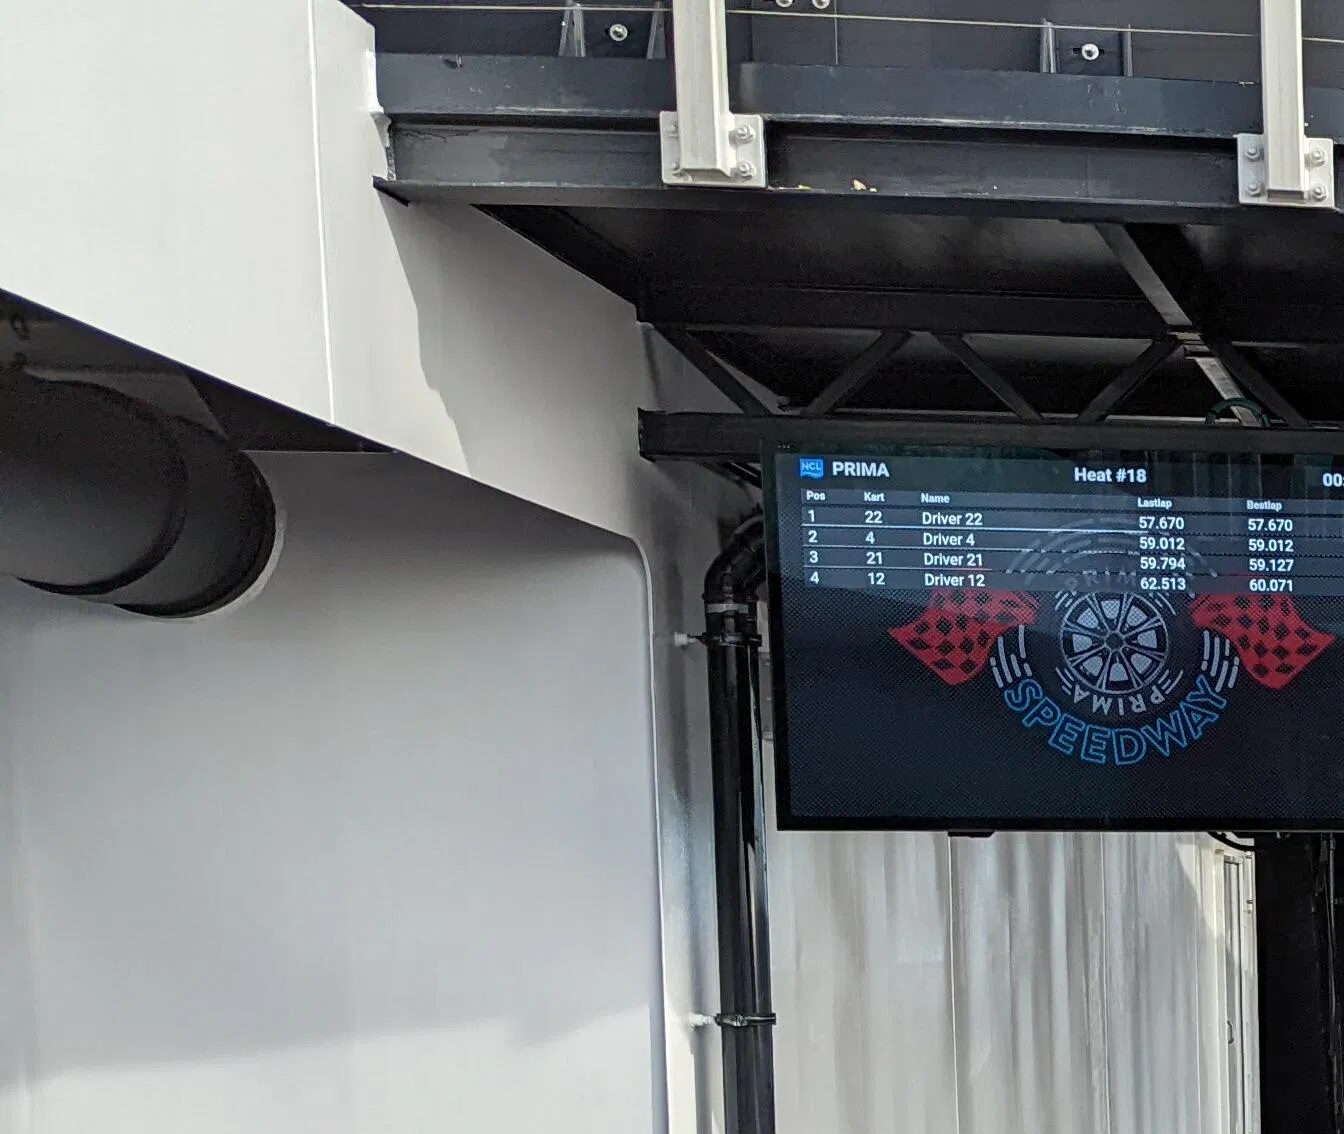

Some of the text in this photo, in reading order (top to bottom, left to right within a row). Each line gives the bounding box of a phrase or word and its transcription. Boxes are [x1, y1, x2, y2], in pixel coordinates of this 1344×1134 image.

[801, 461, 821, 471] NCL
[832, 461, 890, 478] PRIMA
[1074, 467, 1147, 483] Heat #18
[806, 490, 826, 501] Pos
[864, 491, 885, 502] Kart
[920, 493, 950, 504] Name
[1137, 498, 1172, 510] Lastlap
[1246, 500, 1282, 512] Bestlap
[808, 510, 815, 523] 1
[864, 510, 883, 524] 22
[922, 512, 962, 525] Driver
[965, 513, 983, 526] 22
[1138, 516, 1185, 530] 57.670
[1247, 518, 1293, 532] 57.670
[808, 530, 818, 543] 2
[865, 531, 876, 545] 4
[923, 533, 963, 546] Driver
[965, 533, 976, 546] 4
[1139, 536, 1186, 551] 59.012
[1248, 538, 1294, 553] 59.012
[809, 550, 819, 564] 3
[866, 551, 883, 565] 21
[923, 553, 963, 566] Driver
[966, 554, 983, 567] 21
[1140, 556, 1186, 571] 59.794
[1249, 558, 1294, 572] 59.127
[810, 571, 820, 584] 4
[867, 572, 885, 586] 12
[924, 573, 964, 587] Driver
[968, 574, 986, 587] 12
[1140, 576, 1186, 591] 62.513
[1249, 578, 1293, 592] 60.071
[1073, 684, 1166, 716] PRIMA
[1003, 673, 1227, 766] SPEEDWAY
